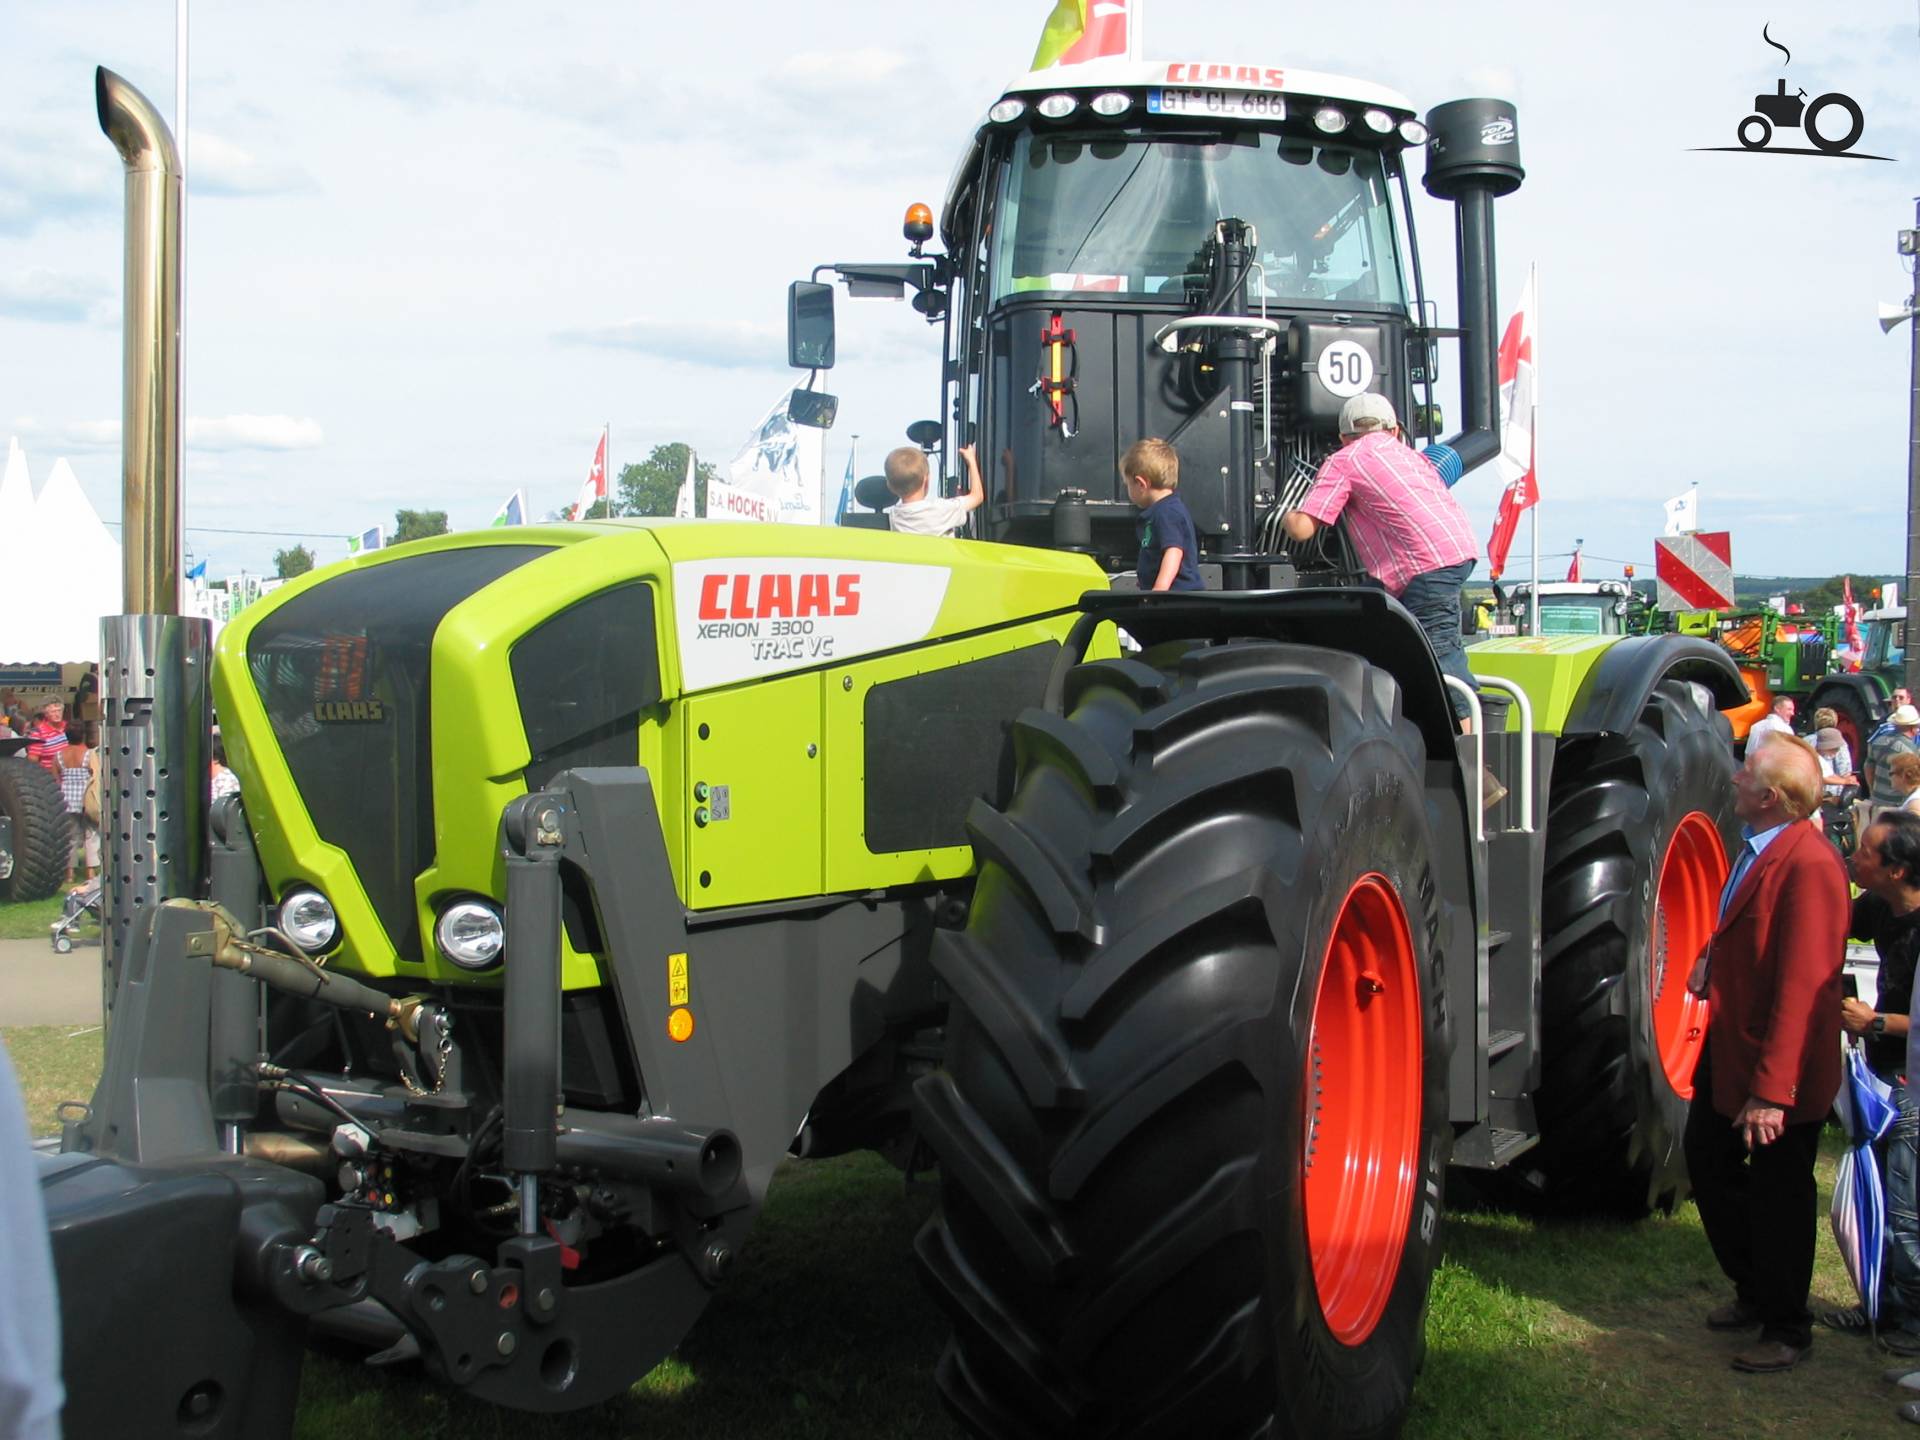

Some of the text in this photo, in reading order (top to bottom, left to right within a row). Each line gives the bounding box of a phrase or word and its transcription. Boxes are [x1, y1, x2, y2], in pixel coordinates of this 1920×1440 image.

[1166, 63, 1284, 88] CLAAS
[1241, 93, 1282, 115] 686
[1330, 351, 1362, 385] 50
[727, 493, 765, 522] HOCKÉ
[699, 574, 860, 620] CLAAS
[697, 620, 814, 639] XERION 3300
[752, 635, 834, 660] TRAC VC
[314, 702, 383, 721] CLAAS
